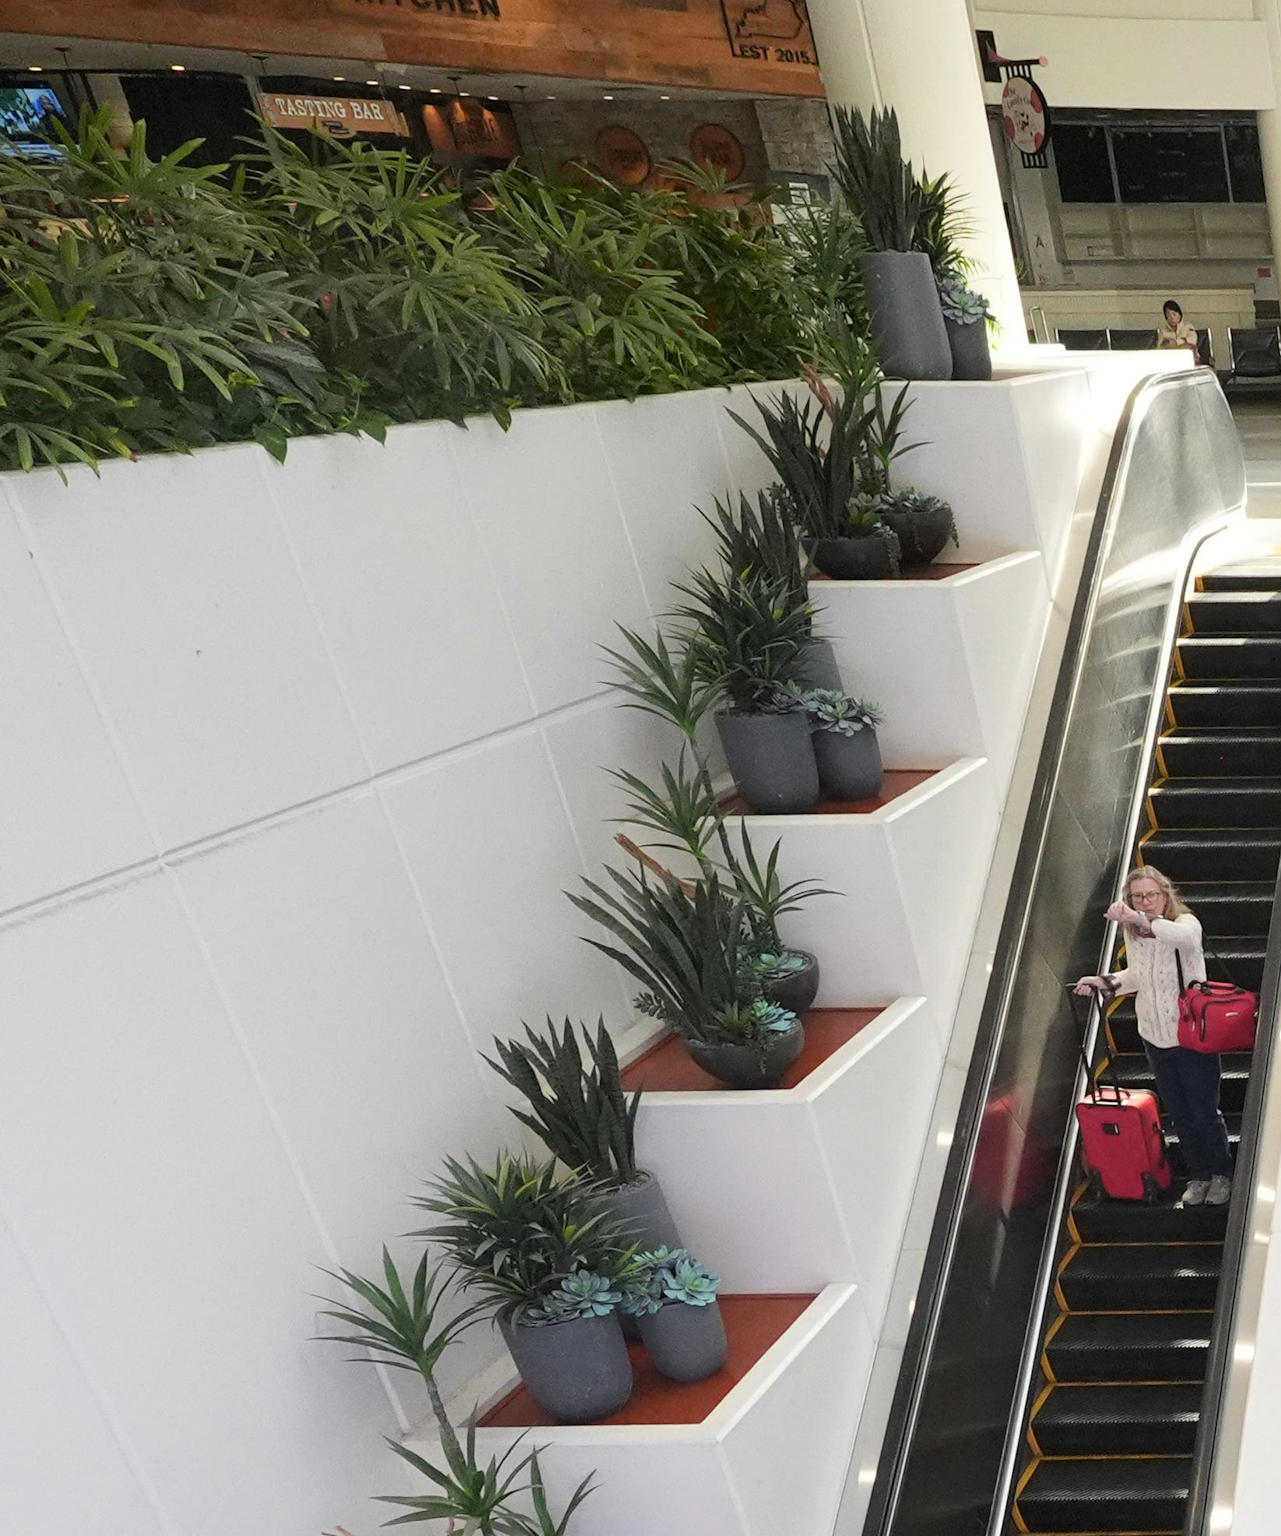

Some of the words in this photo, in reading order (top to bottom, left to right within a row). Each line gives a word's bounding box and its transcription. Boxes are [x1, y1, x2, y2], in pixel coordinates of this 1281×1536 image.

[740, 44, 769, 60] EST
[775, 48, 809, 64] 2015
[274, 98, 347, 119] TASTING
[350, 101, 384, 121] BAR
